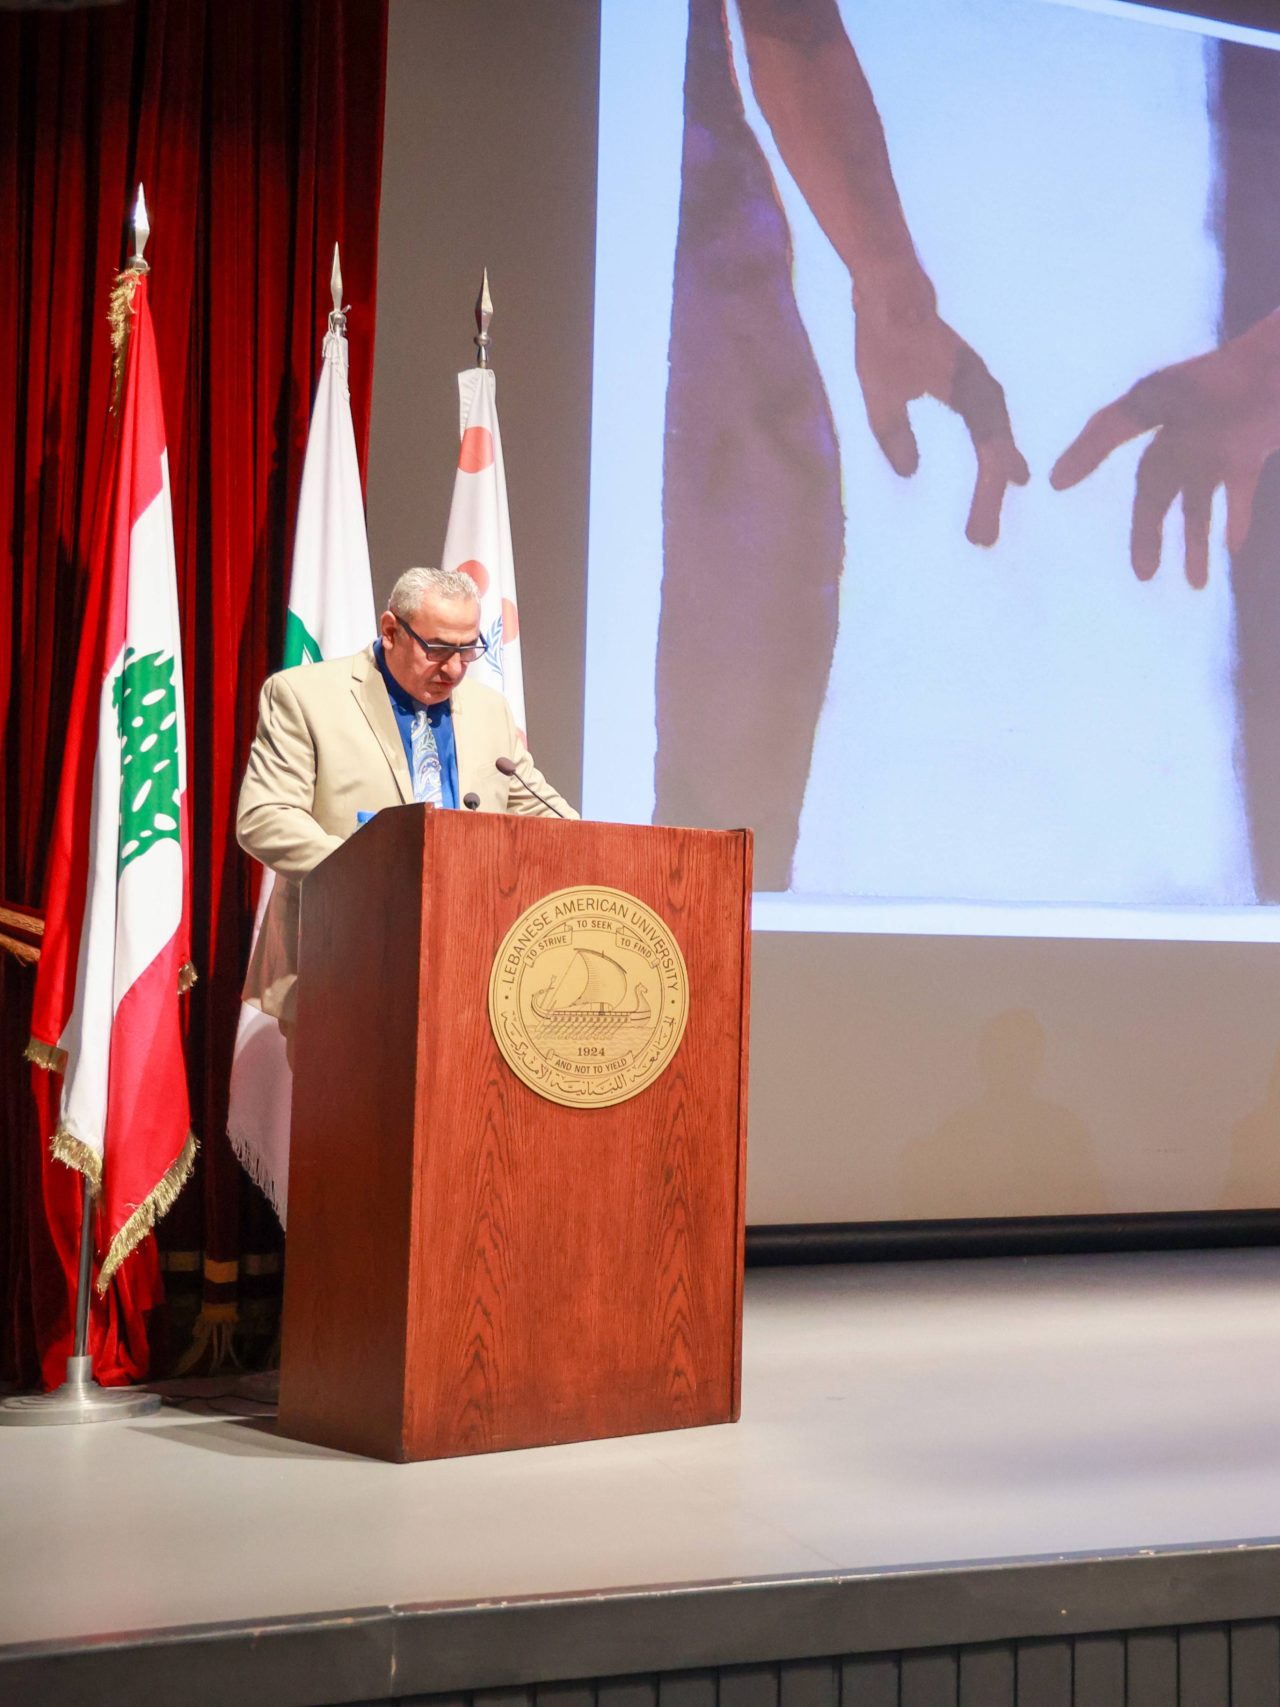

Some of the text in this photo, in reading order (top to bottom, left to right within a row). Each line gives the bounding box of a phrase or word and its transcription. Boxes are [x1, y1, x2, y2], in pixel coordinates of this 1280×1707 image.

[577, 920, 612, 930] TO SEEK
[502, 897, 679, 991] LEBANESE AMERICAN UNIVERSITY
[526, 935, 568, 961] TO STRIVE
[620, 938, 652, 959] TO FIND
[577, 1047, 605, 1056] 1924
[555, 1058, 627, 1074] AND NOT TO YIELD
